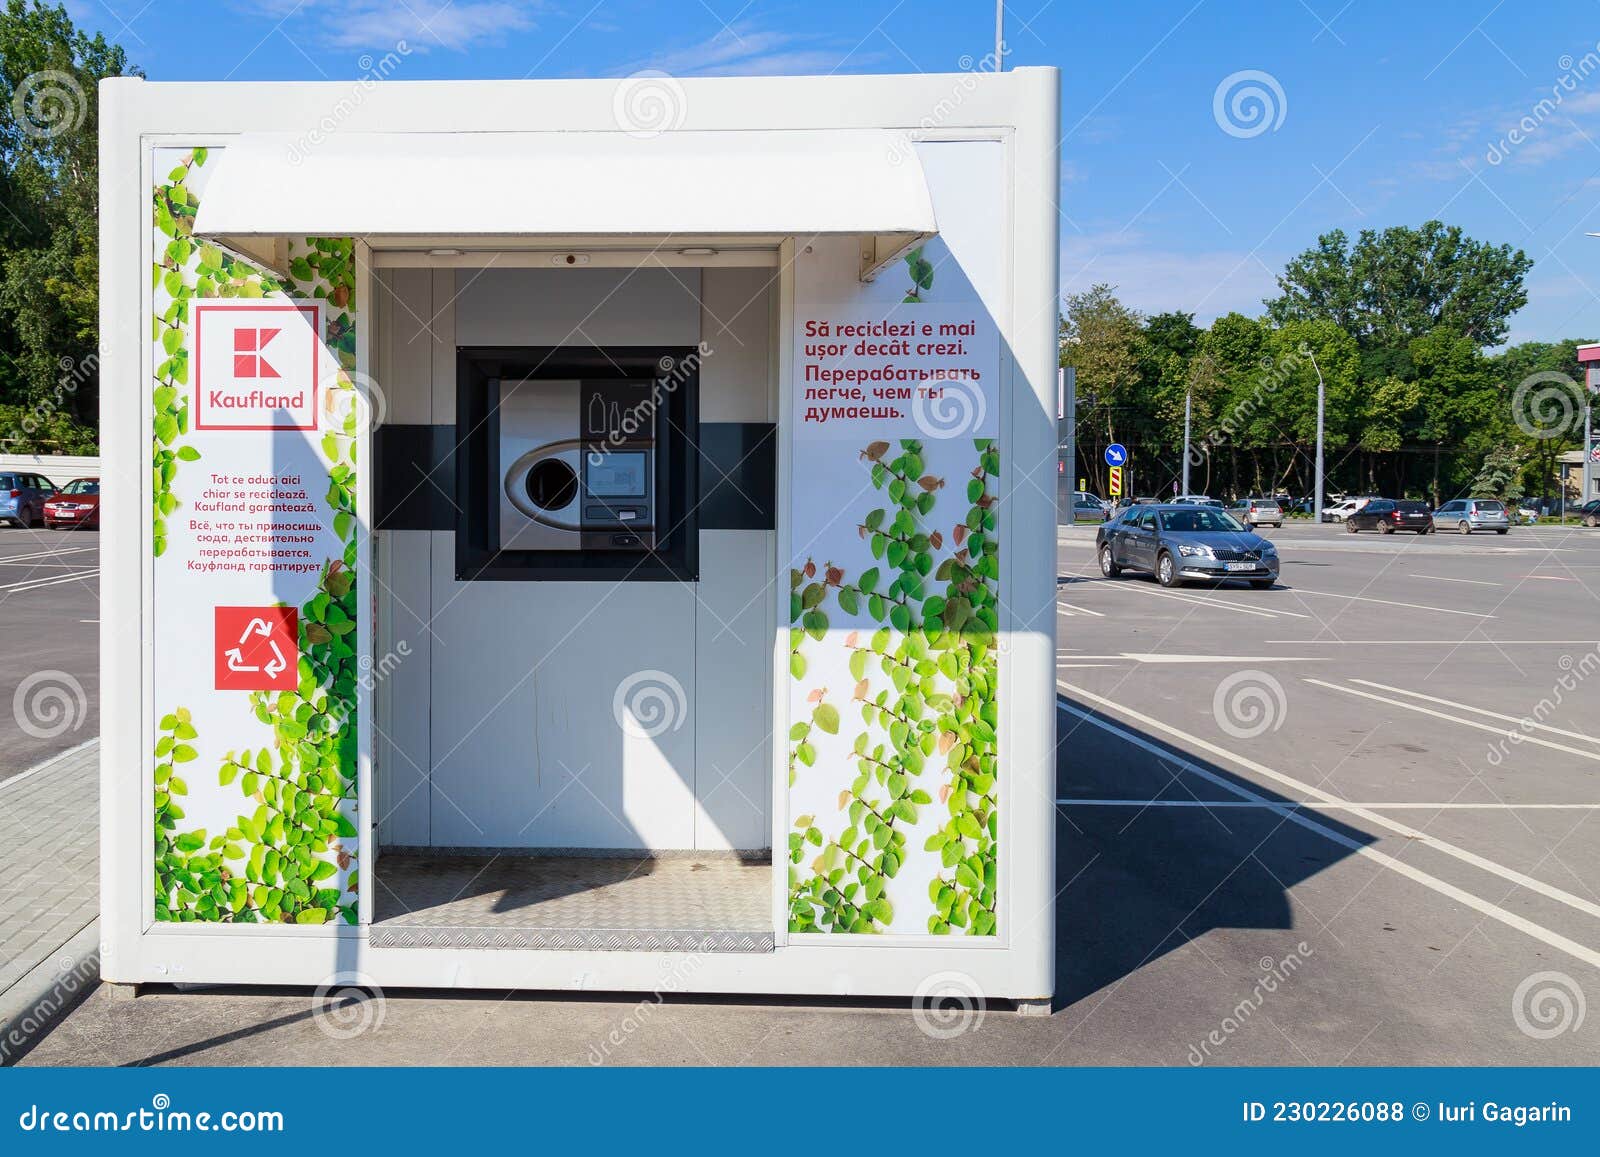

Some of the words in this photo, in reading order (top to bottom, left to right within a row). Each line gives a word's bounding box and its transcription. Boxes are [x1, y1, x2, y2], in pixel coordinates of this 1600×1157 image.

[805, 320, 830, 337] Să
[836, 320, 915, 337] reciclezi
[922, 324, 933, 337] e
[939, 320, 976, 336] mai
[805, 343, 848, 360] ușor
[854, 339, 910, 356] decât
[916, 339, 968, 355] crezi.
[805, 364, 981, 385] Перерабатывать
[210, 390, 304, 409] Kaufland
[805, 388, 866, 402] легче,
[873, 387, 911, 400] чем
[918, 387, 944, 399] ты
[804, 406, 905, 423] думаешь.
[210, 474, 229, 484] Tot
[232, 476, 244, 484] ce
[247, 475, 278, 484] aduci
[281, 475, 301, 485] aici
[202, 489, 231, 499] chiar
[234, 491, 246, 499] se
[249, 489, 308, 499] reciclează.
[194, 501, 245, 512] Kaufland
[249, 502, 317, 514] garantează.
[189, 520, 212, 531] Всё,
[215, 522, 235, 531] что
[238, 522, 253, 531] ты
[256, 522, 322, 532] приносишь
[196, 534, 231, 544] сюда,
[234, 534, 314, 544] дествительно
[199, 547, 312, 559] перерабатывается.
[187, 560, 245, 573] Кауфланд
[249, 562, 324, 573] гарантирует.
